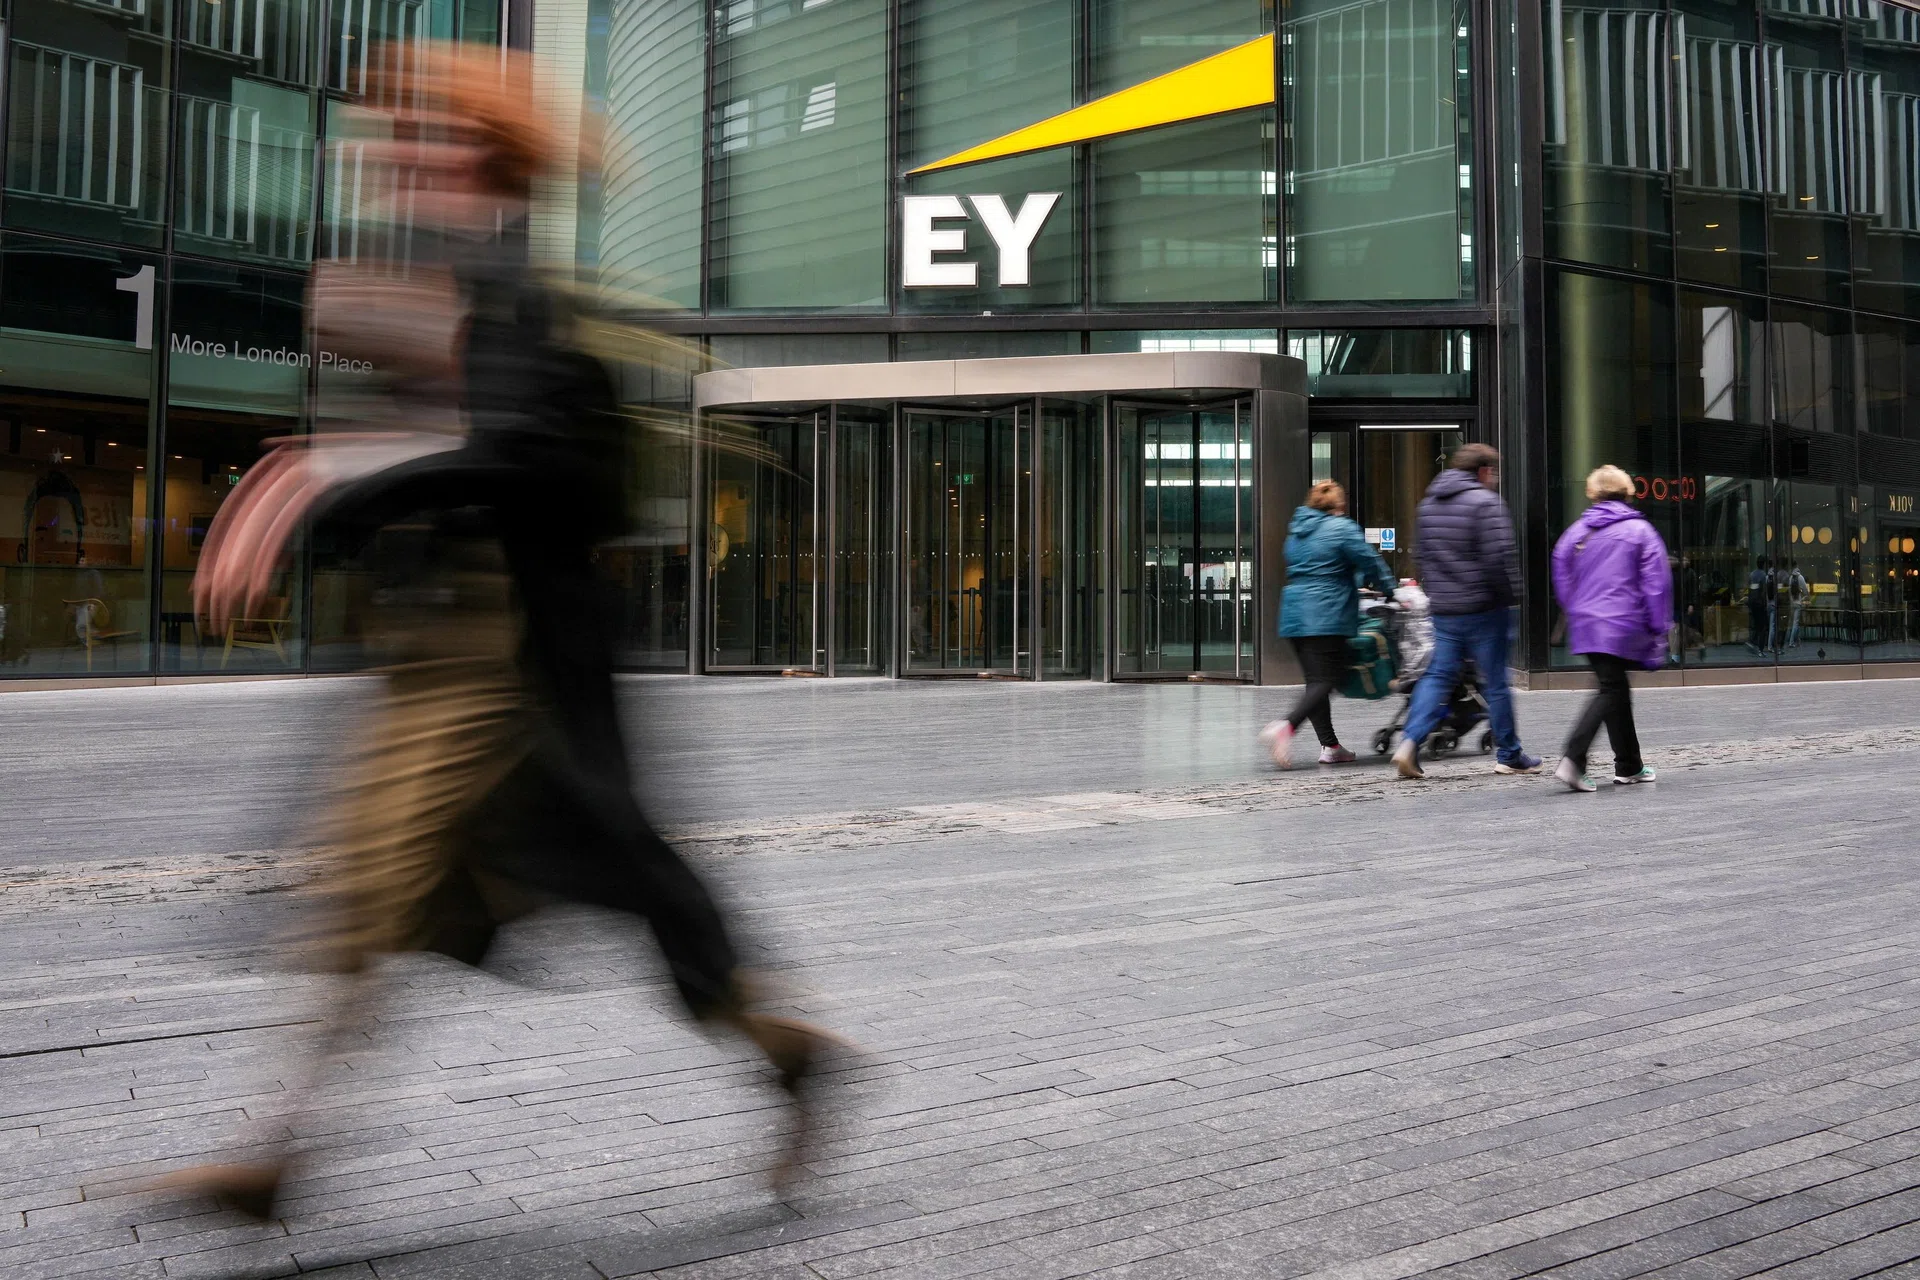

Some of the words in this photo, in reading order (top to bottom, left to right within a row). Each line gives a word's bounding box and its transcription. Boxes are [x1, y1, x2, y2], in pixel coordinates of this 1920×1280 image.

[902, 192, 1063, 289] EY
[116, 265, 155, 349] 1
[171, 333, 226, 359] More
[234, 341, 311, 368] London
[319, 351, 373, 375] Place
